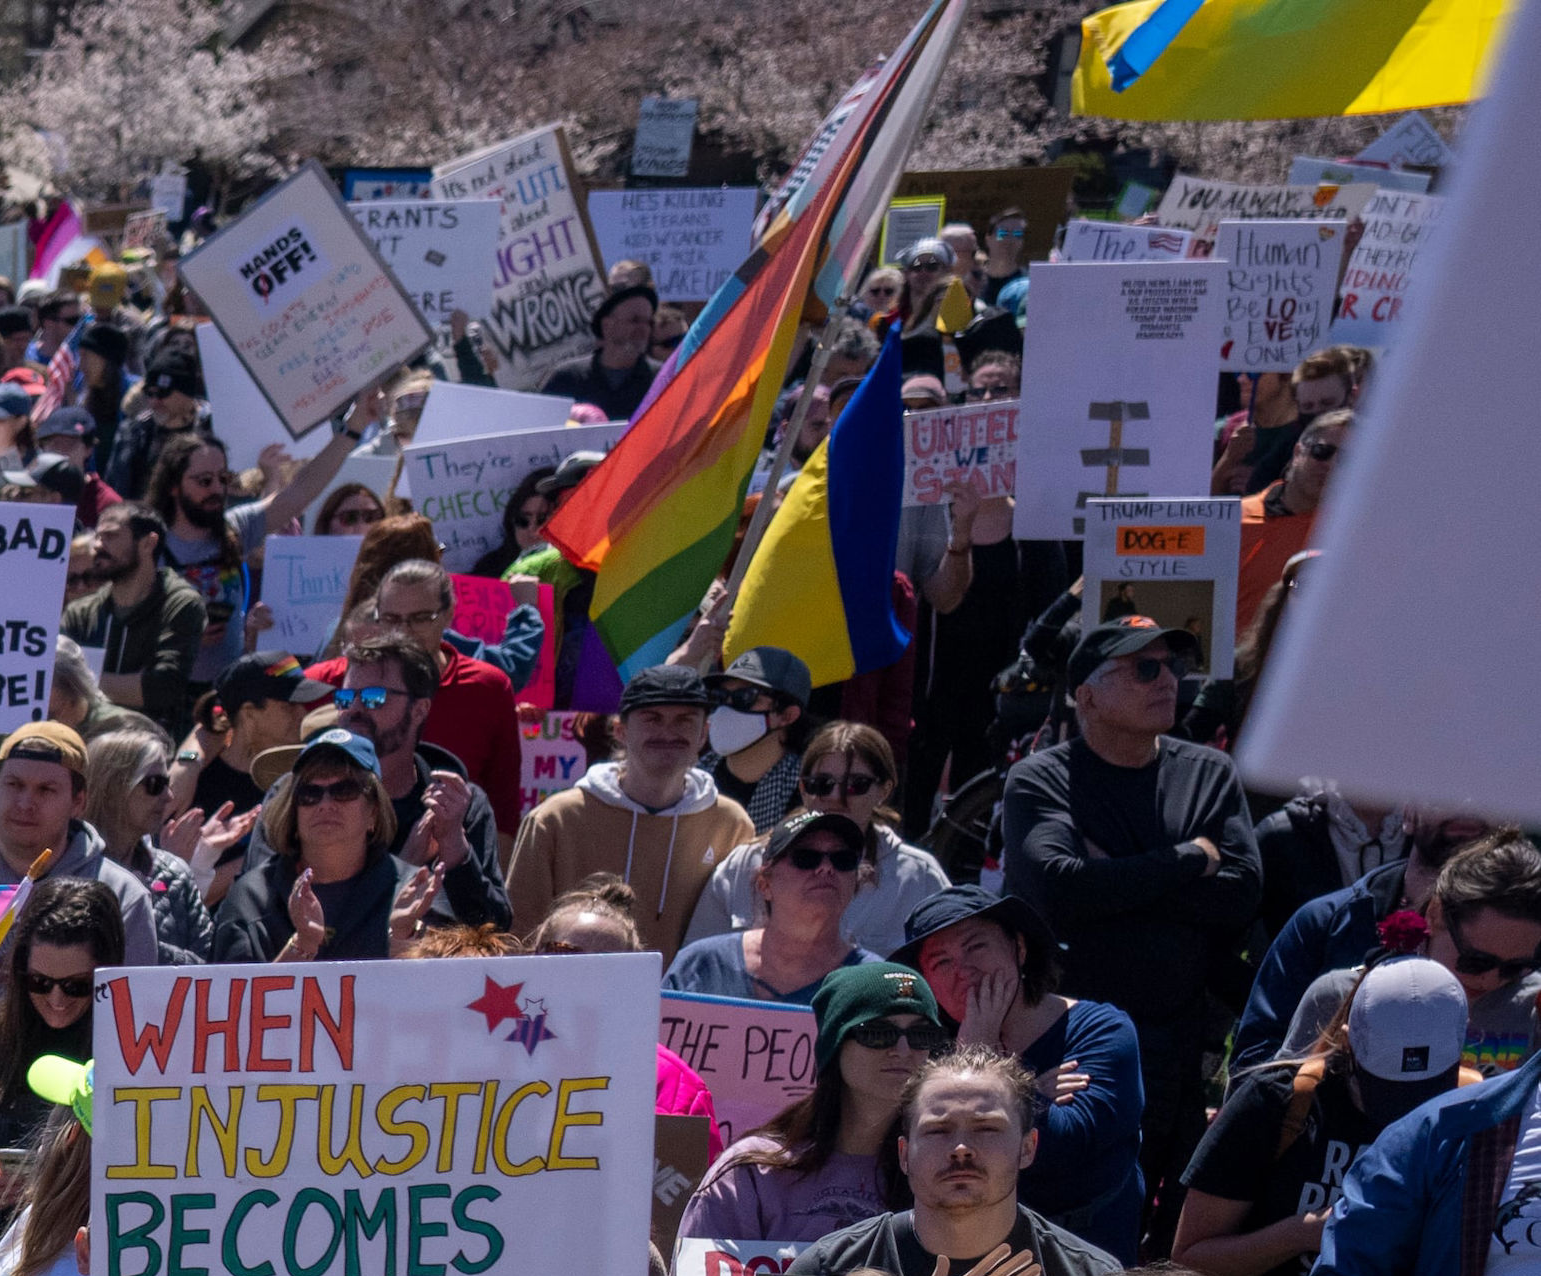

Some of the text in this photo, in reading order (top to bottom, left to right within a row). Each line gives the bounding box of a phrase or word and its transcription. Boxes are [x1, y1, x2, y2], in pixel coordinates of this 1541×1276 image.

[516, 163, 566, 206] LEFT
[239, 227, 303, 280] HANDS
[1234, 229, 1321, 268] Human
[252, 240, 318, 299] OFF!
[1227, 269, 1313, 298] Rights
[419, 451, 514, 483] They're
[955, 449, 989, 467] WE
[1097, 502, 1235, 521] TRUMP LIKES IT
[1124, 530, 1192, 551] DOG-E
[1120, 559, 1188, 578] STYLE
[534, 756, 578, 780] MY
[662, 1016, 730, 1073] THE
[106, 1077, 611, 1180] INJUSTICE
